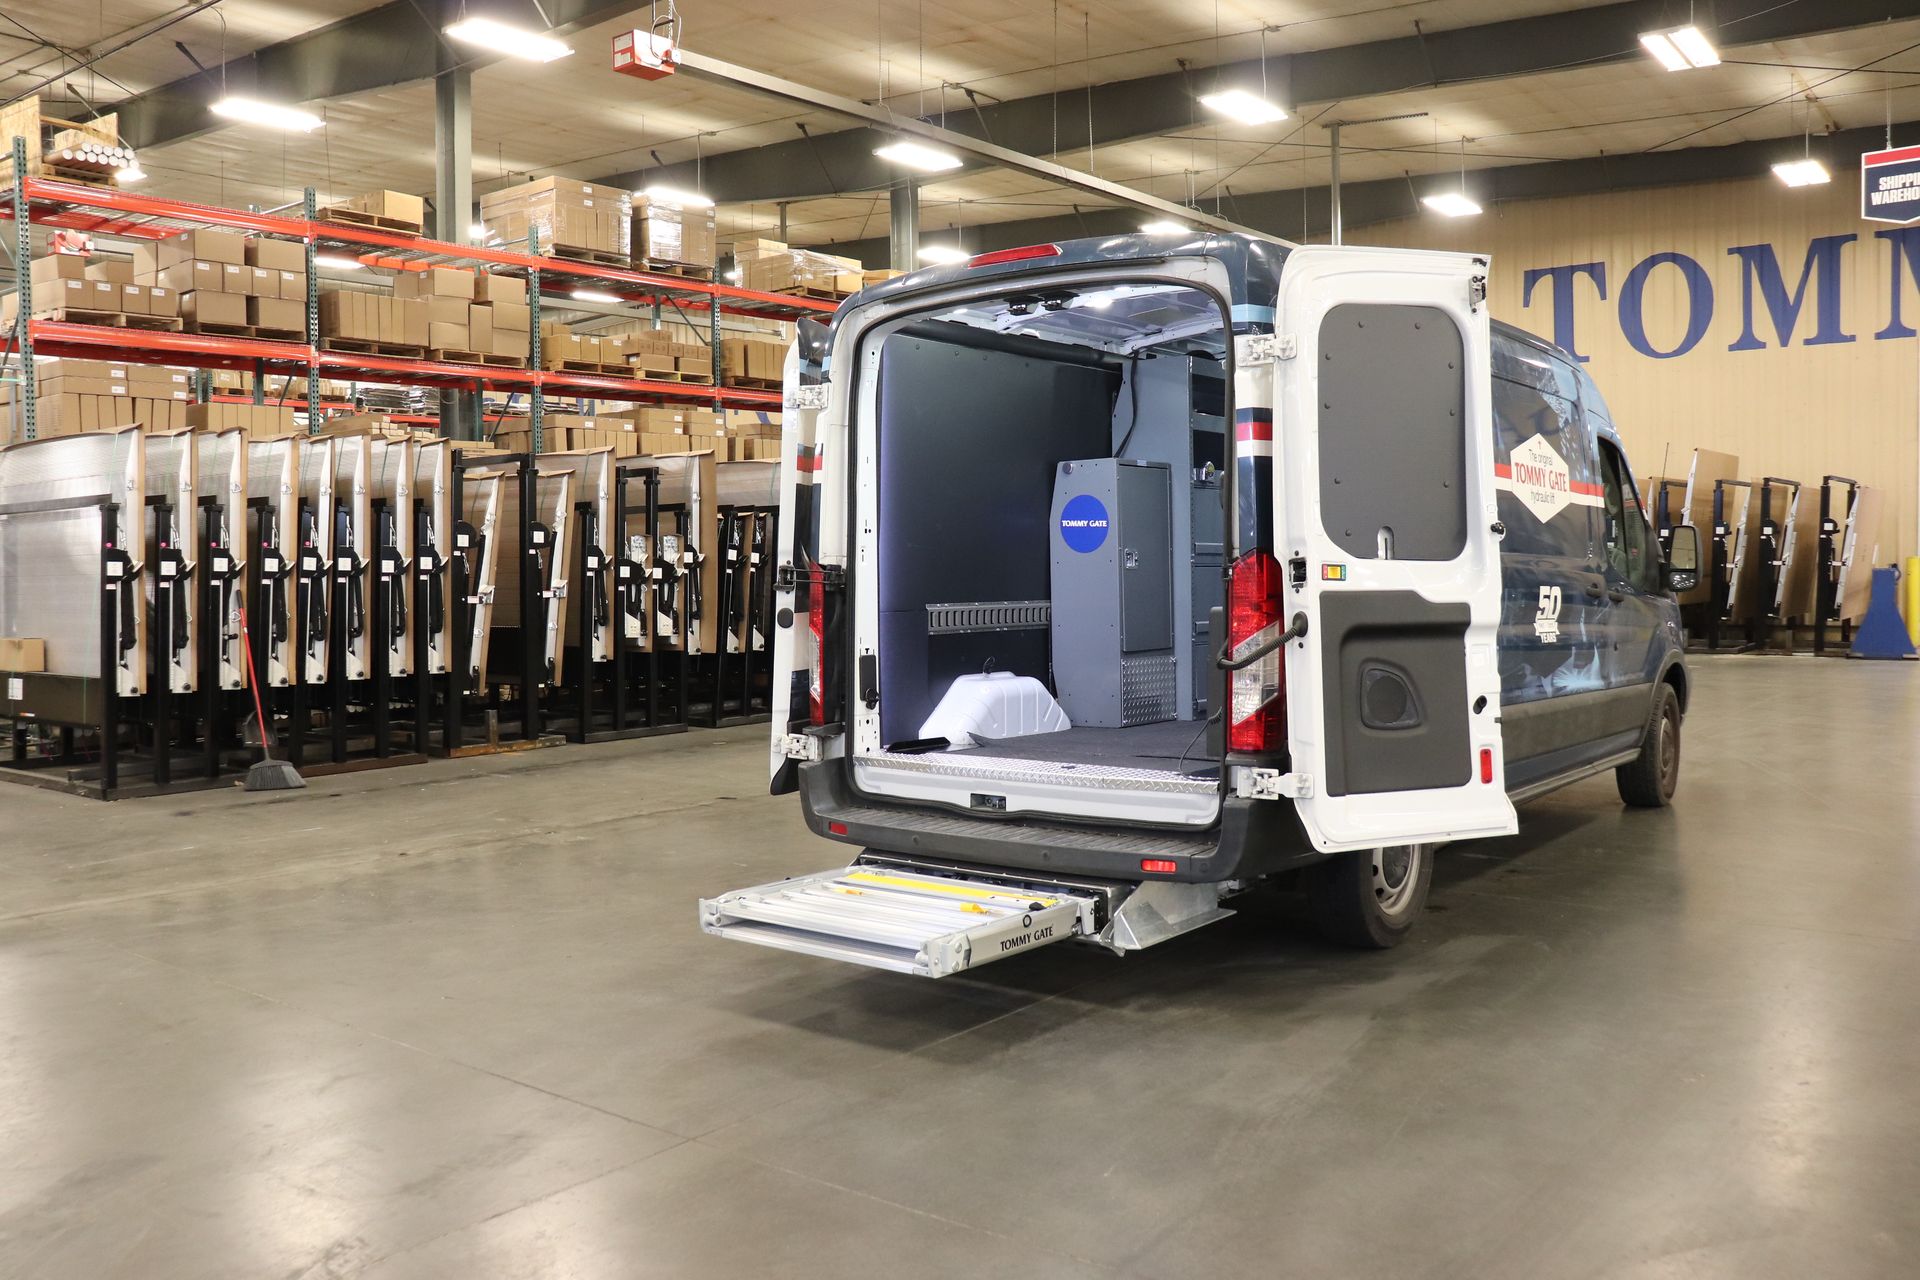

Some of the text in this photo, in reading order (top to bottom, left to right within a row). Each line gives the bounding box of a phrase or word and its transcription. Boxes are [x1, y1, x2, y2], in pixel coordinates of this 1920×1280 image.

[1515, 462, 1567, 492] TOMMY GATE
[1535, 585, 1562, 619] 50
[1000, 926, 1054, 951] TOMMY GATE
